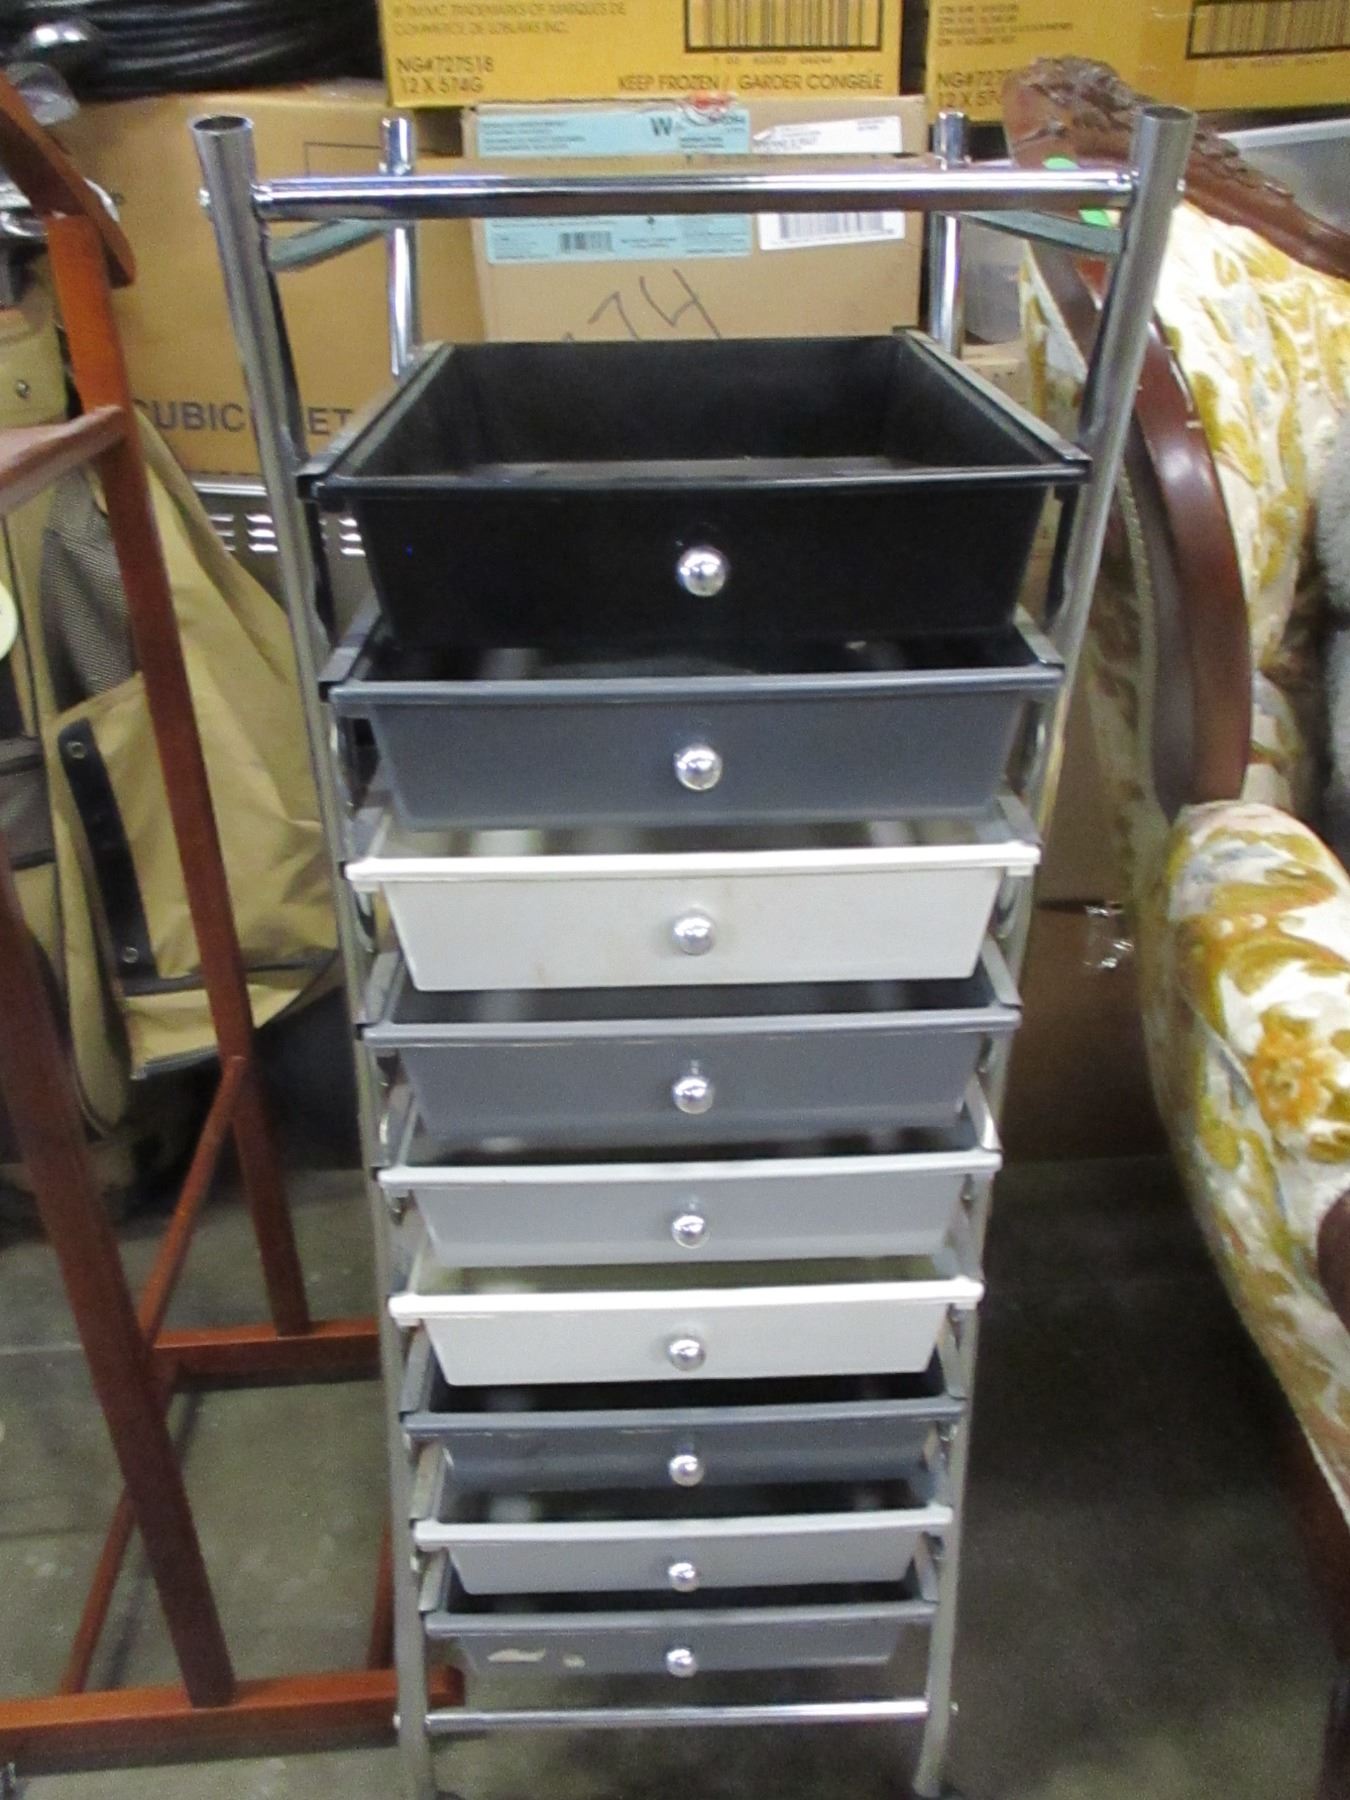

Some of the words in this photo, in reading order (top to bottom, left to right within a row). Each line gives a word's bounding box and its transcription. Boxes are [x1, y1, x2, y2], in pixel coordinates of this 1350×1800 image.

[401, 77, 418, 94] 12
[422, 77, 436, 94] X
[618, 74, 654, 91] KEEP
[659, 74, 719, 91] FROZEN
[738, 73, 803, 90] GARDER
